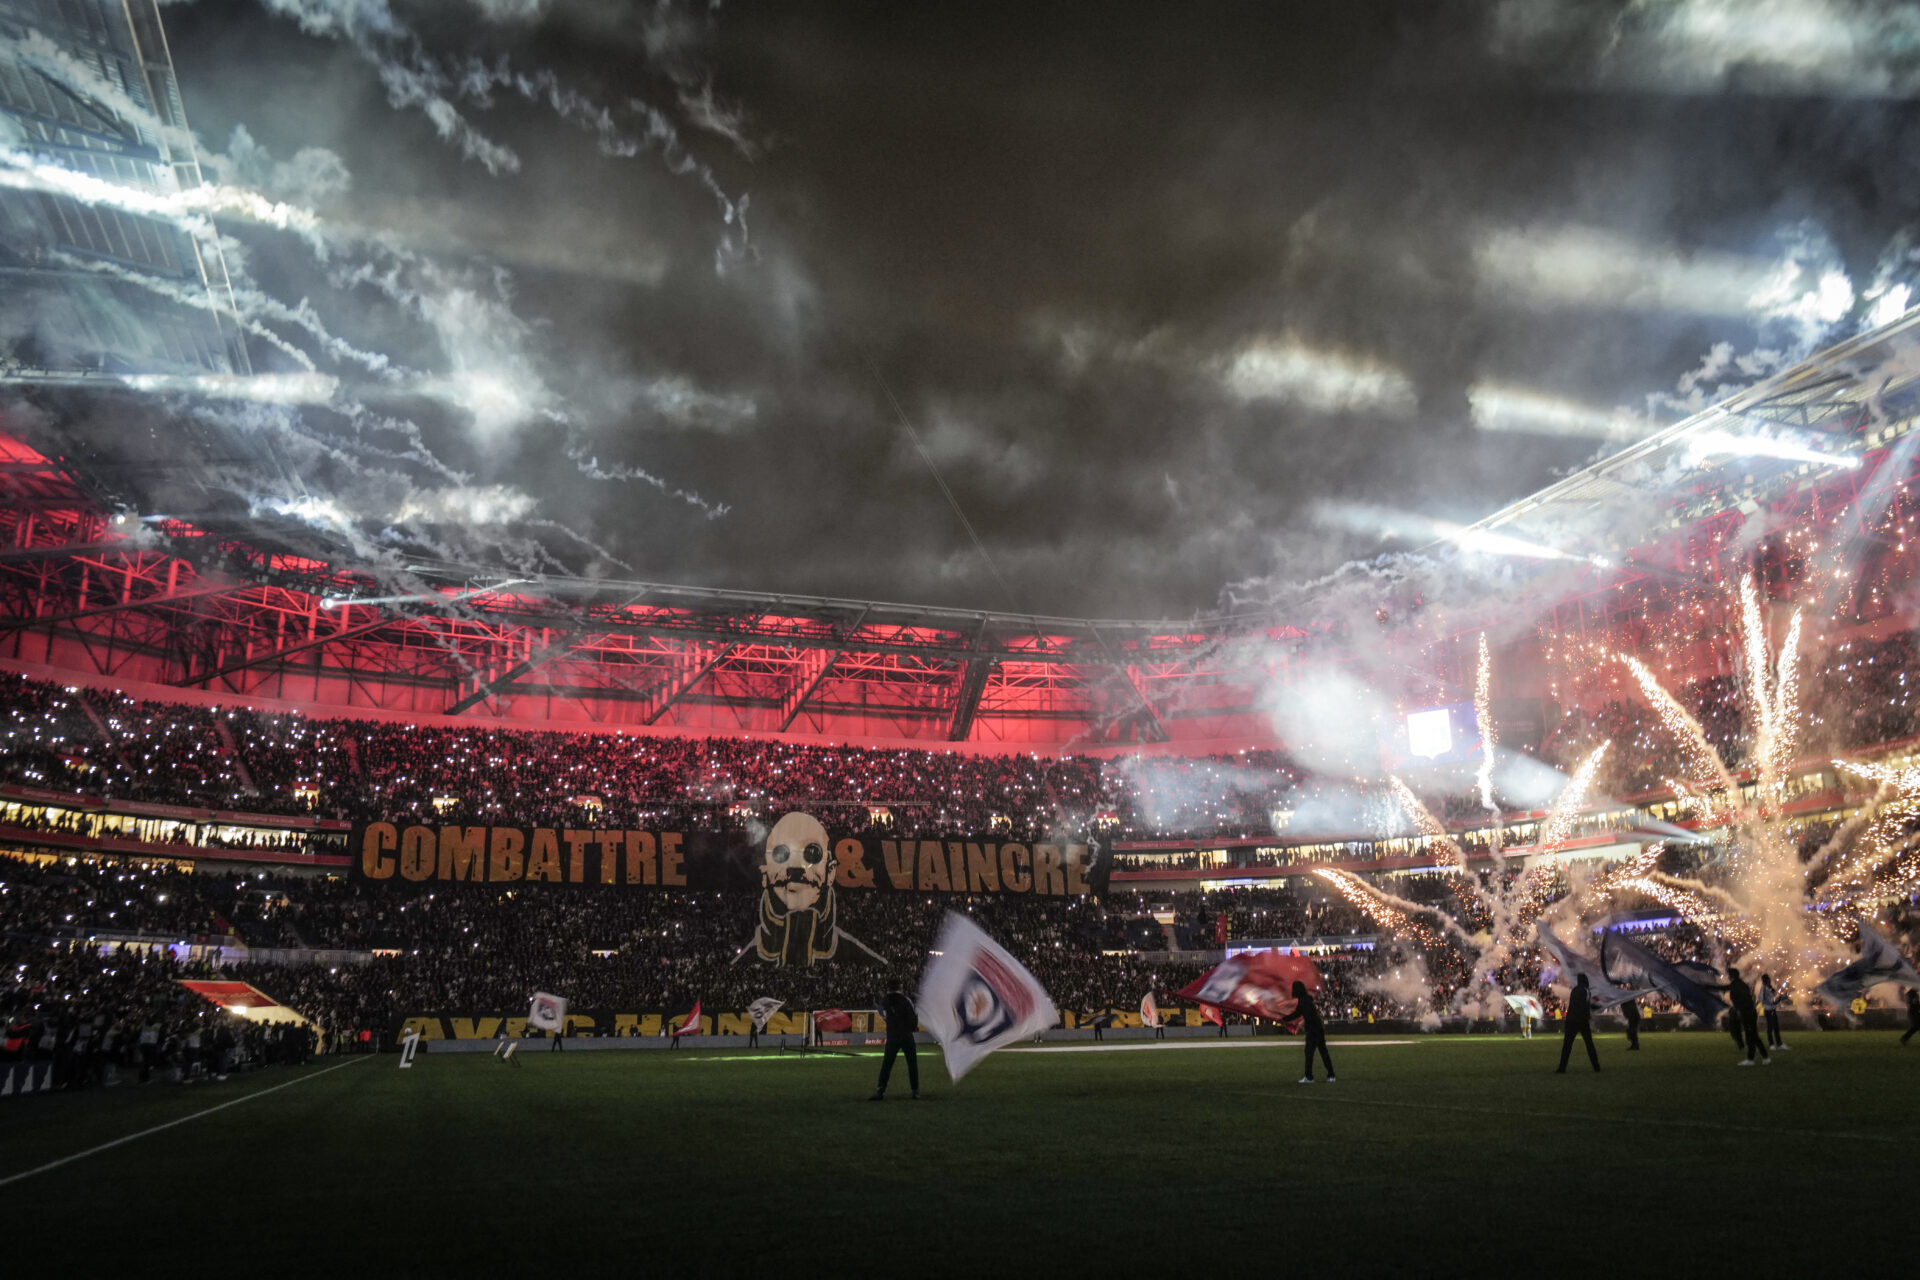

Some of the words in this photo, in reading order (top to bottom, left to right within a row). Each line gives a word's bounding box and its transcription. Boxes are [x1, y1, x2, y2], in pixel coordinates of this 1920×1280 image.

[362, 822, 687, 886] COMBATTRE
[835, 838, 876, 889] &
[881, 840, 1091, 895] VAINCRE
